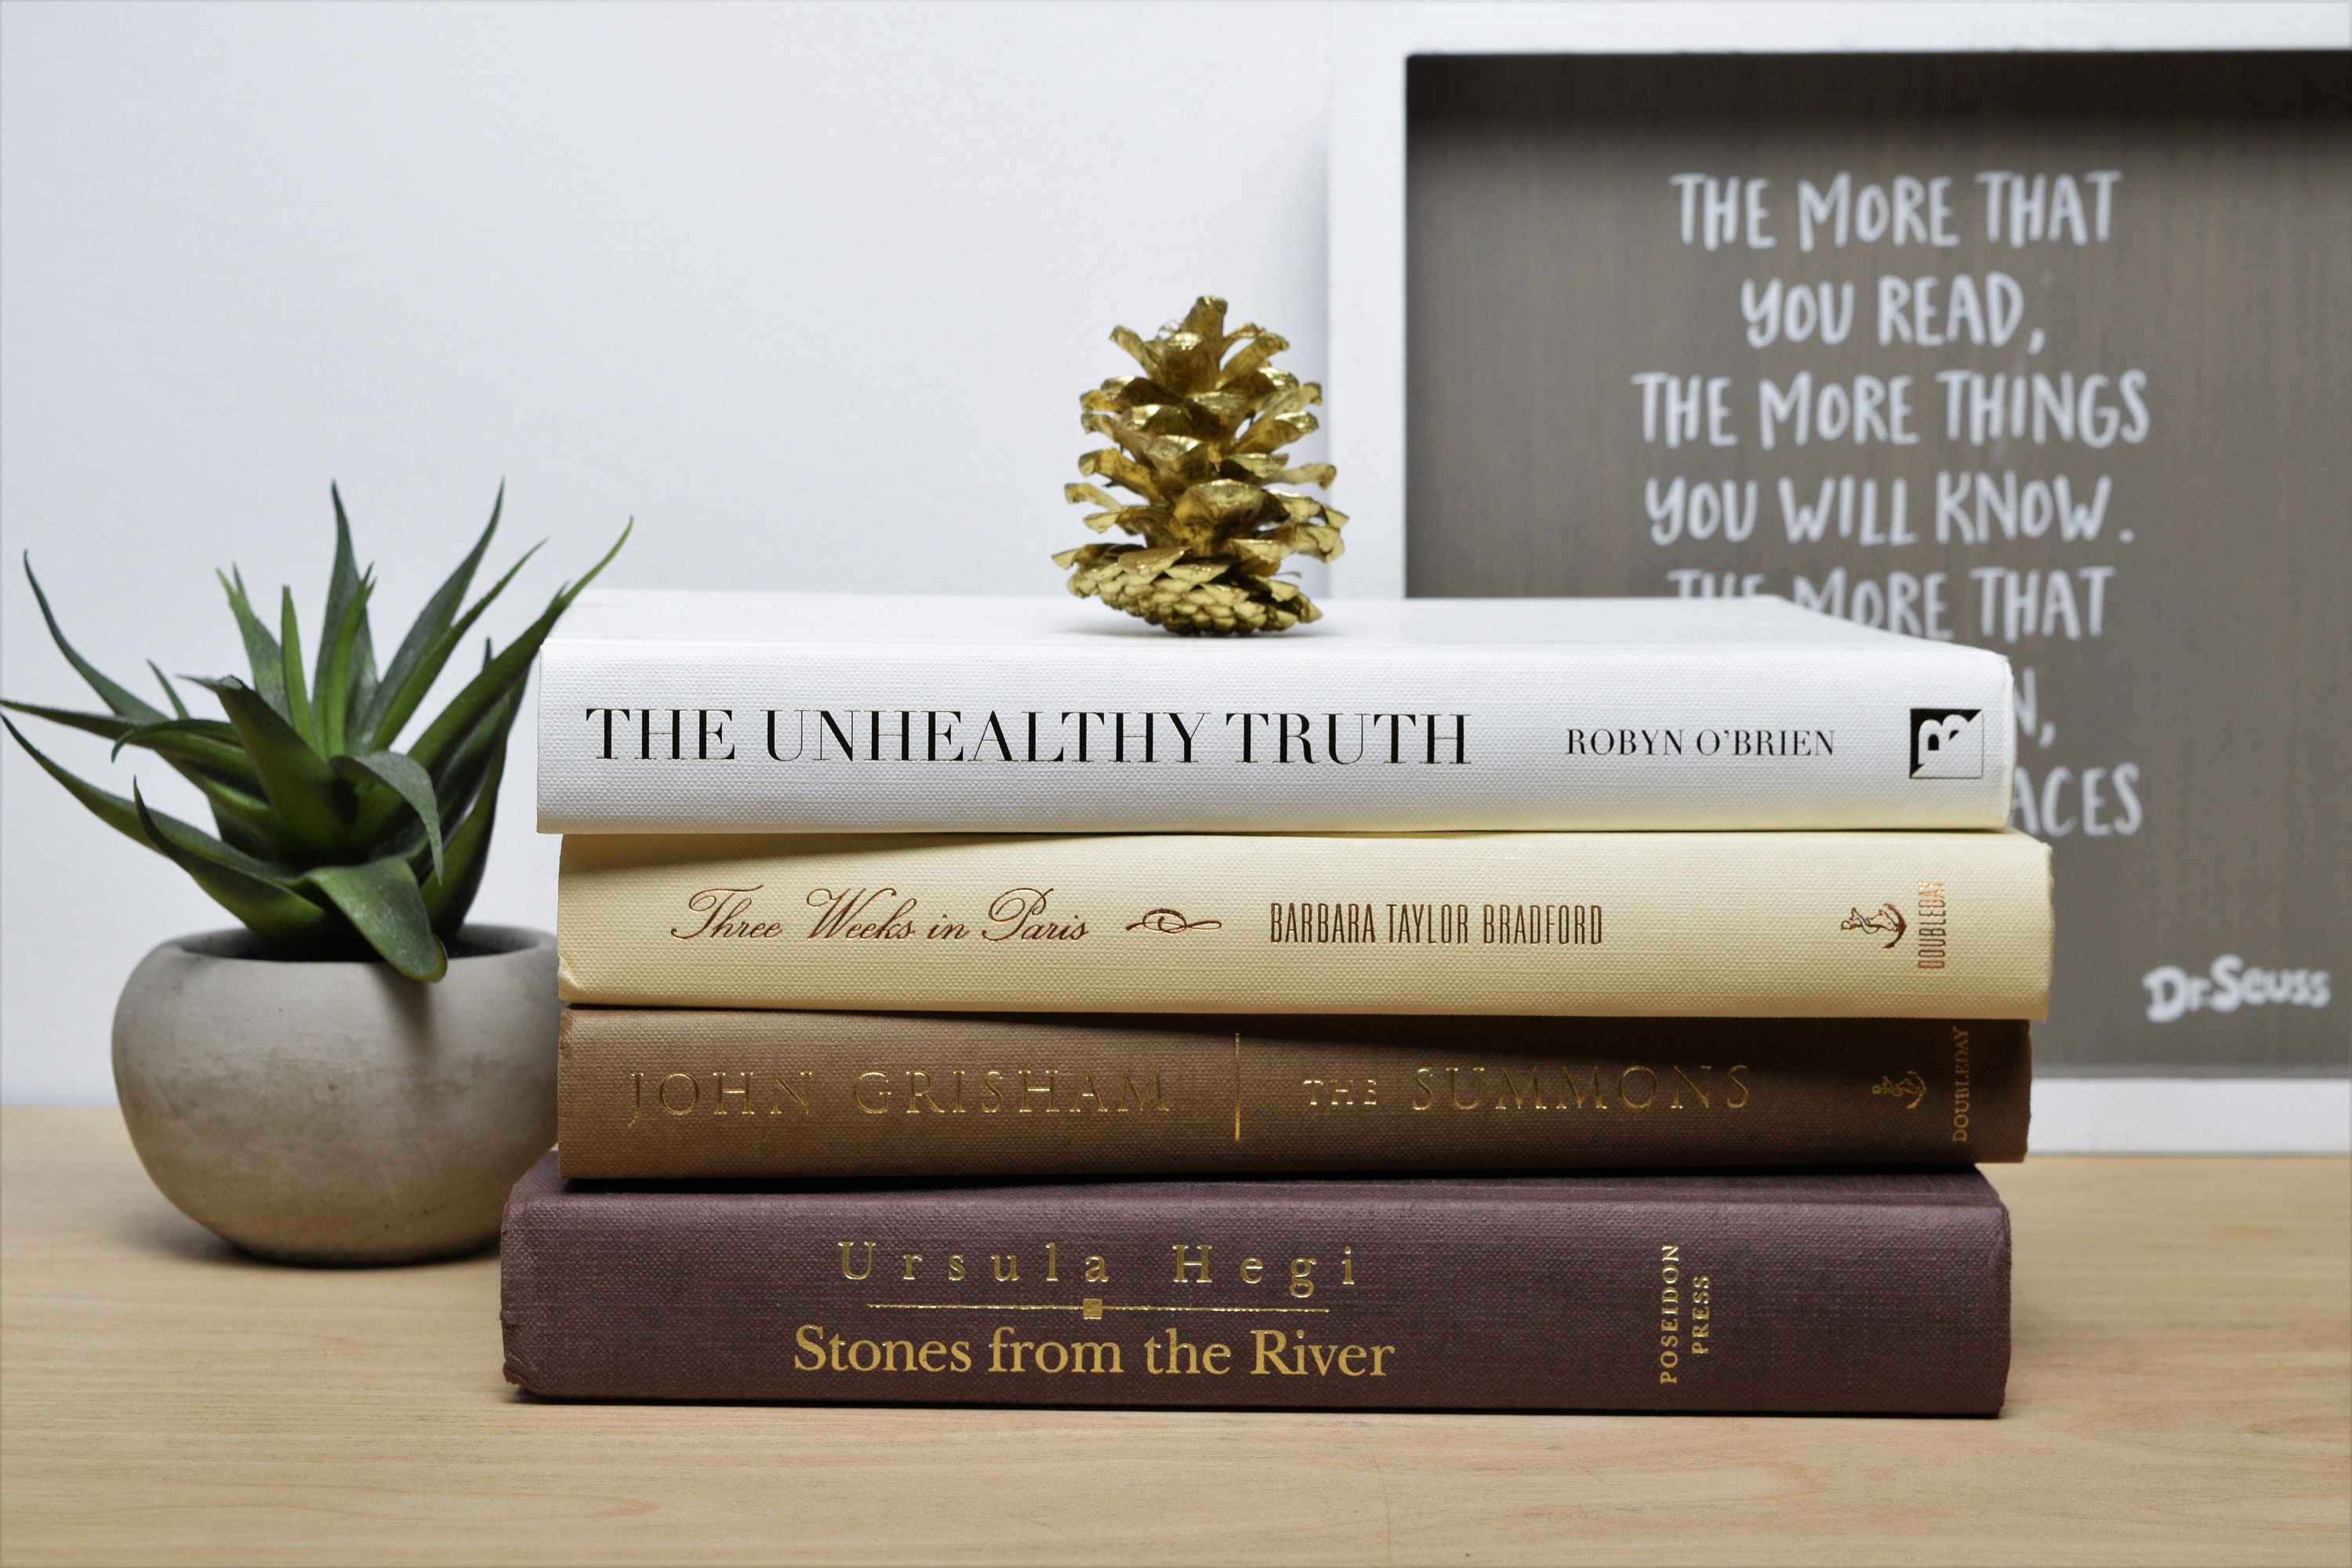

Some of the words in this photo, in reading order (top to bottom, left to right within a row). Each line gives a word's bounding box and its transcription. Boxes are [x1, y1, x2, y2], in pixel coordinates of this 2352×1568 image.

[1669, 172, 1777, 252] THE
[1797, 169, 1960, 252] MORE
[1975, 169, 2124, 249] THAT
[1740, 276, 1856, 349] YOU
[1878, 270, 2046, 355] READ,
[1630, 371, 1738, 448] THE
[1758, 369, 1921, 450] MORE
[1935, 368, 2151, 448] THINGS
[1644, 475, 1759, 546] YOU
[1777, 474, 1918, 546] WILL
[1935, 470, 2136, 545] KNOW.
[1792, 566, 1955, 641] MORE
[1969, 566, 2116, 642] THAT
[586, 708, 735, 760] THE
[760, 709, 1210, 764] UNHEALTHY
[1225, 712, 1472, 765] TRUTH
[1566, 728, 1683, 756] ROBYN
[1696, 729, 1835, 757] O'BRIEN
[670, 884, 782, 941] Three
[806, 887, 917, 941] Weeks
[925, 912, 971, 941] in
[980, 887, 1091, 942] Paris
[1270, 902, 1376, 944] BARBARA
[1386, 904, 1470, 945] TAYLOR
[1482, 904, 1603, 946] BRADFORD
[1918, 880, 1946, 969] DOUBLEDAY
[628, 1071, 813, 1126] JOHN
[852, 1069, 1170, 1114] GRISHAM
[1303, 1080, 1377, 1105] THE
[1412, 1065, 1750, 1110] SUMMONS
[1952, 1025, 1969, 1142] DOUBLEDAY
[837, 1241, 1109, 1283] Ursula
[1172, 1244, 1355, 1298] Hegi
[793, 1323, 972, 1372] Stones
[988, 1327, 1124, 1374] from
[1145, 1328, 1231, 1374] the
[1250, 1330, 1396, 1377] River
[1660, 1243, 1679, 1385] POSEIDON
[1691, 1274, 1709, 1355] PRESS
